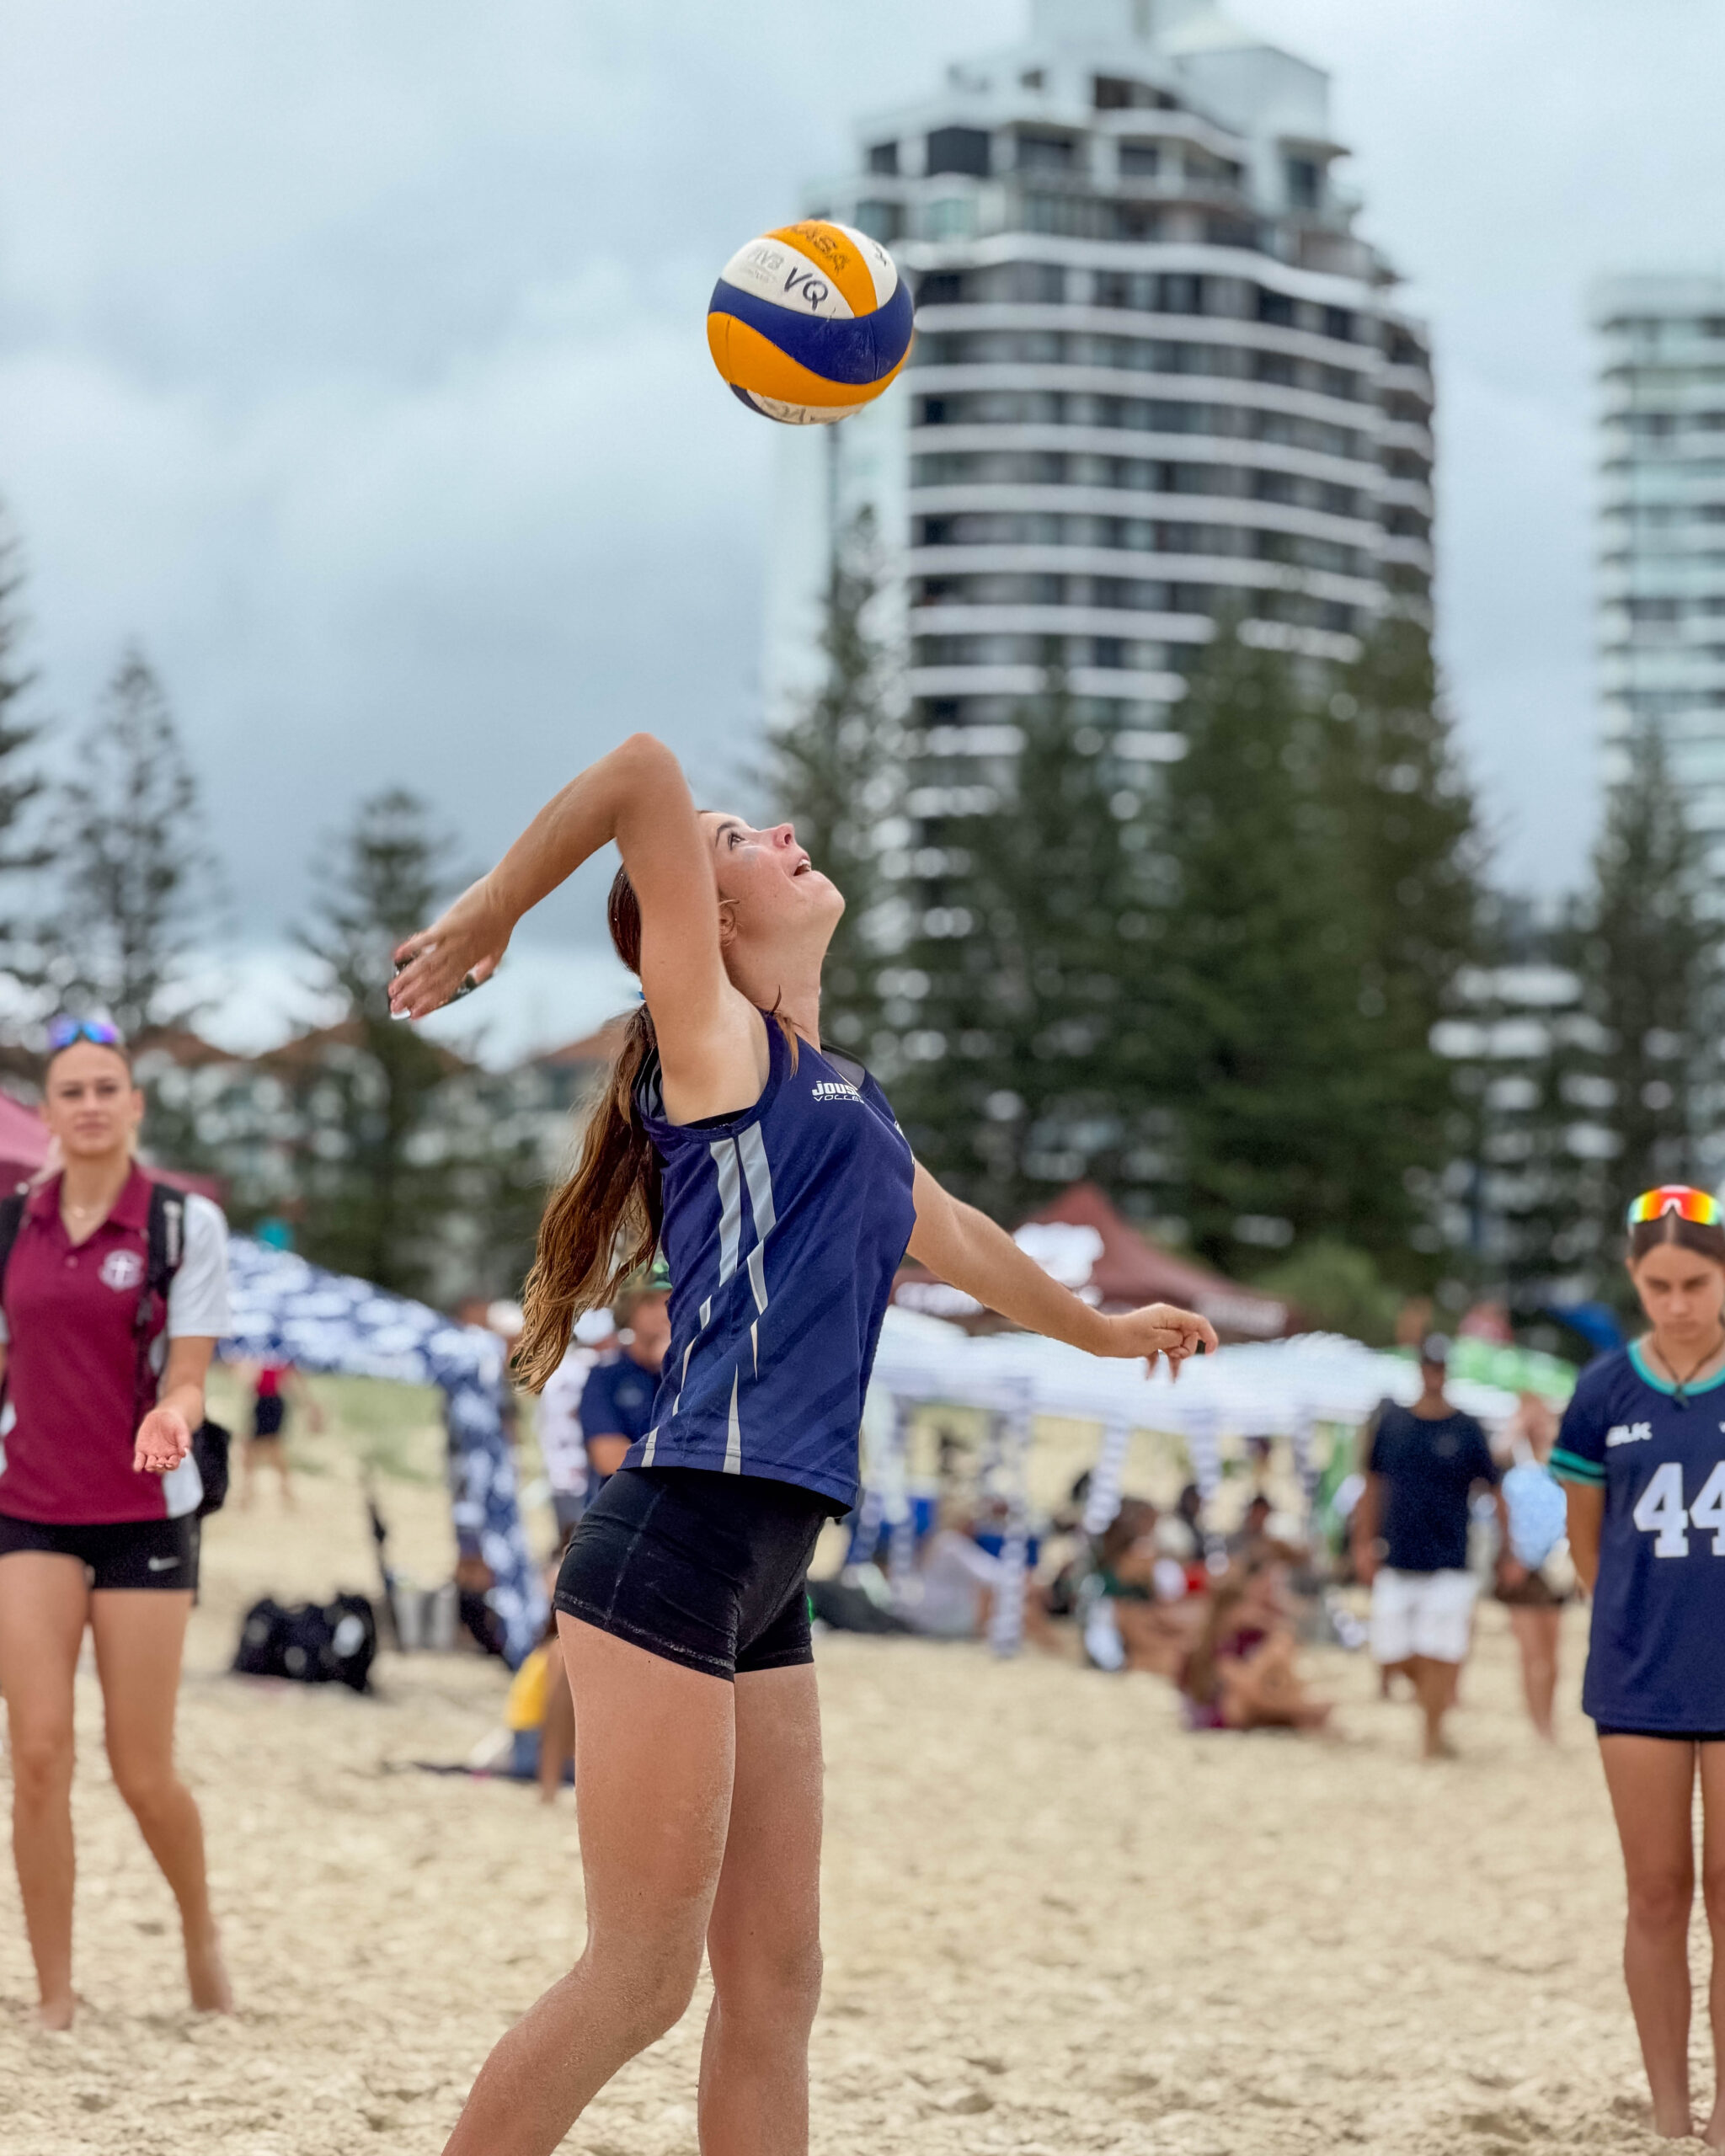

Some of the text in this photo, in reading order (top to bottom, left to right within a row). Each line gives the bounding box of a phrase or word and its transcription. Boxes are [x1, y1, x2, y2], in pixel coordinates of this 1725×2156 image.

[783, 266, 829, 311] VQ
[811, 1080, 861, 1098] JOUS
[1632, 1460, 1725, 1558] 44
